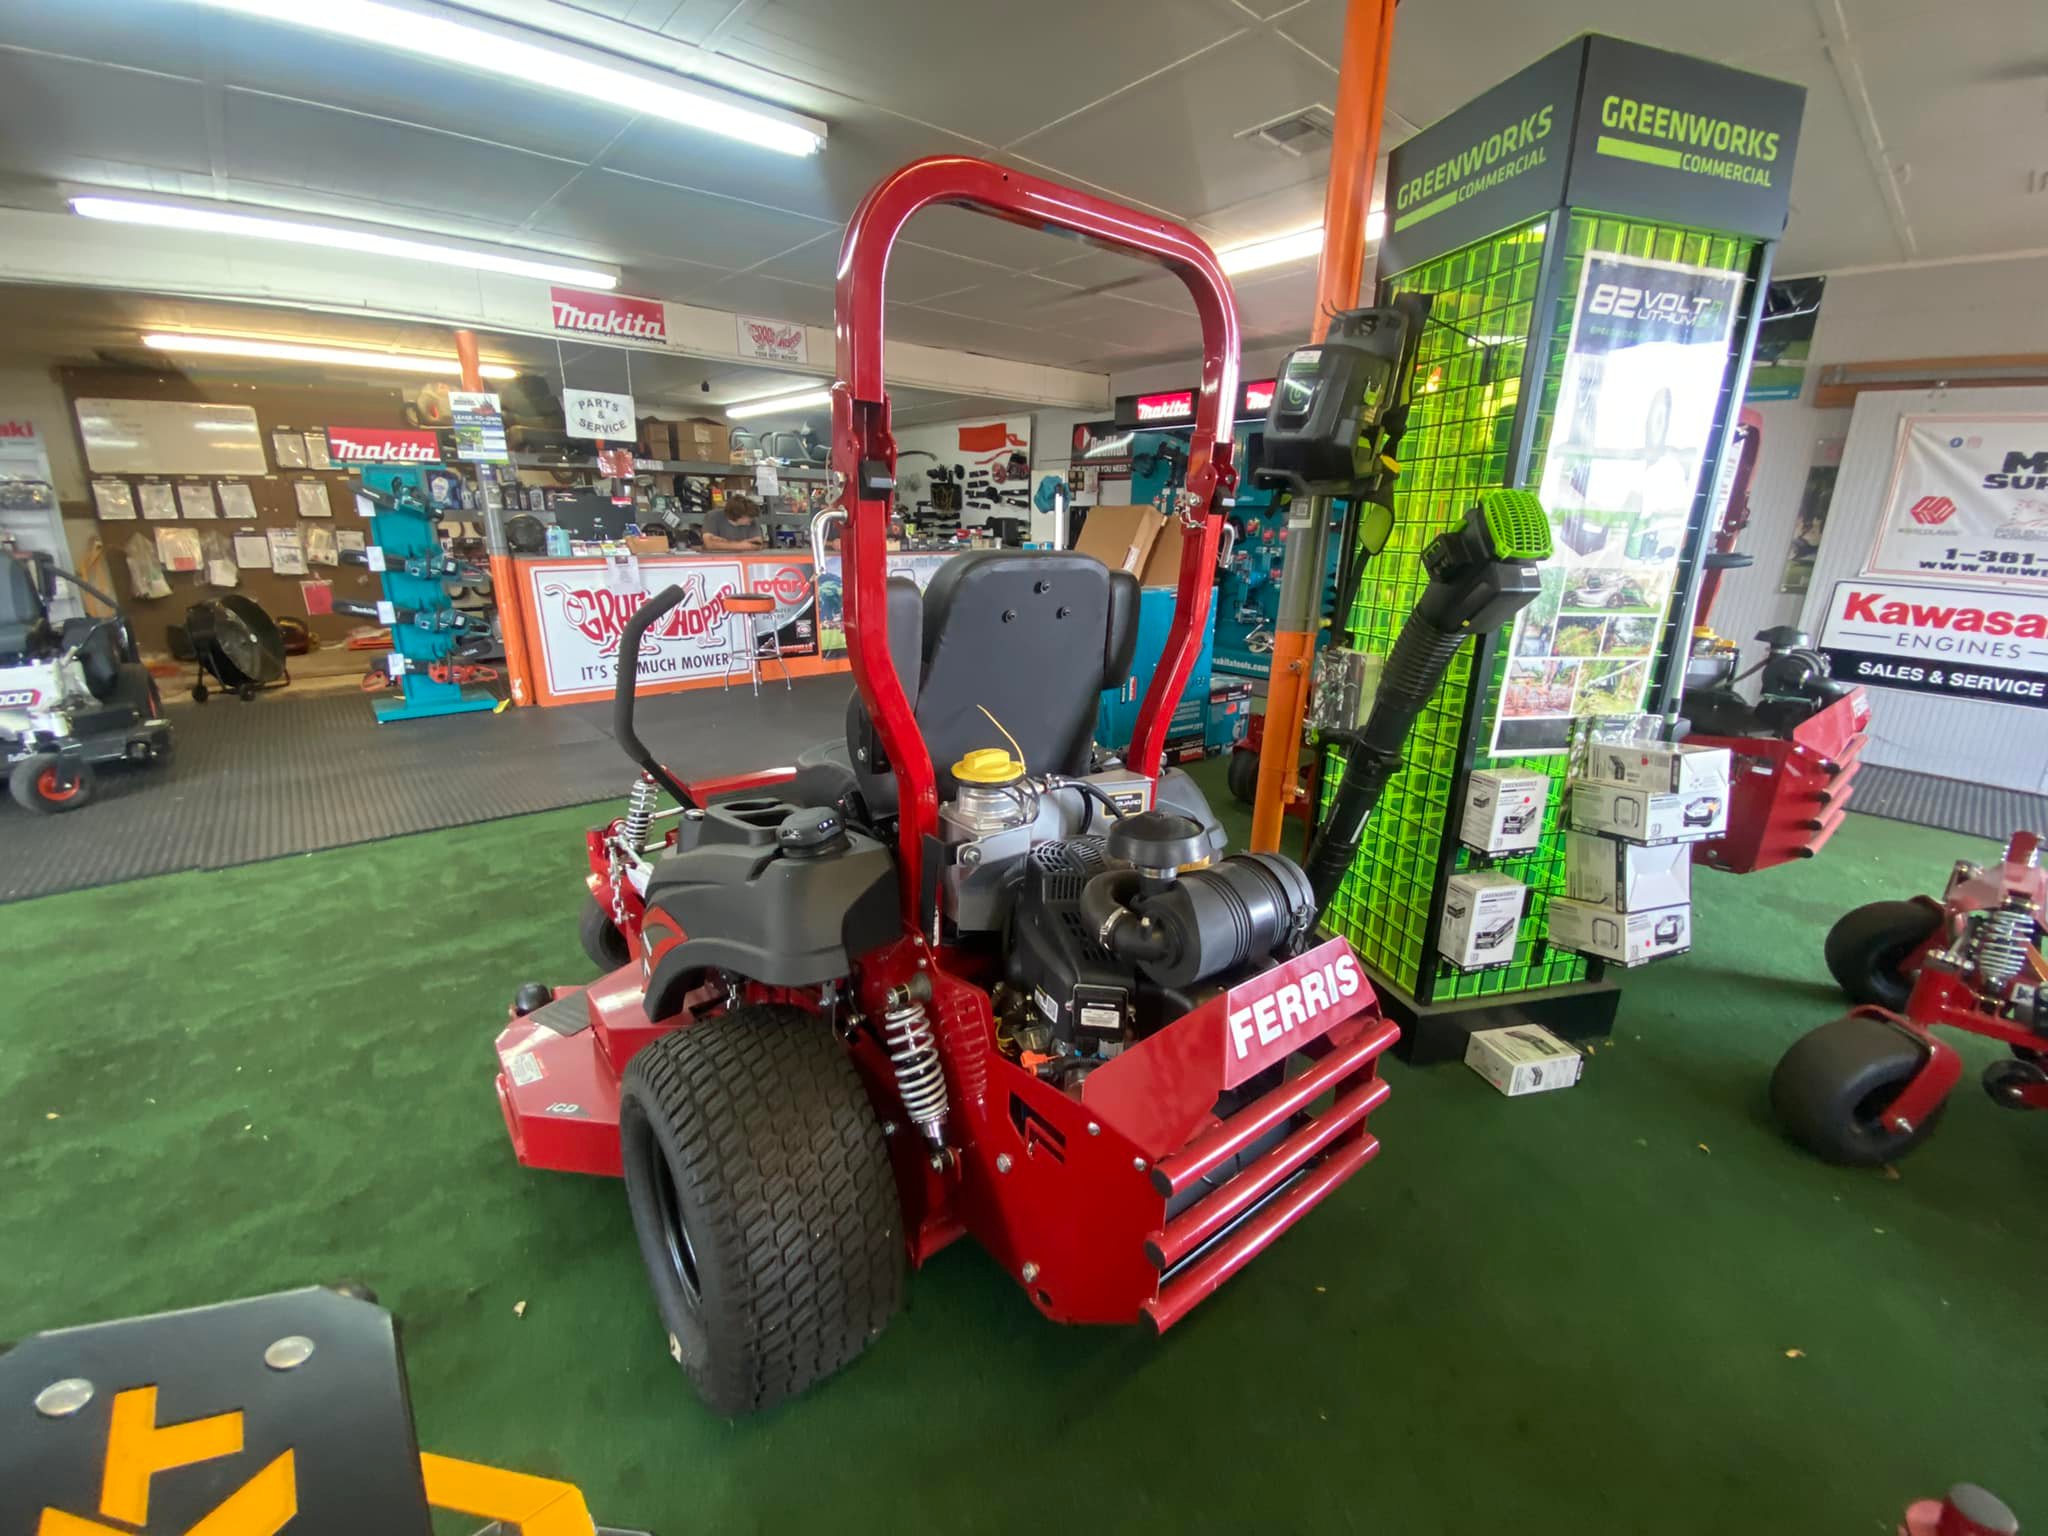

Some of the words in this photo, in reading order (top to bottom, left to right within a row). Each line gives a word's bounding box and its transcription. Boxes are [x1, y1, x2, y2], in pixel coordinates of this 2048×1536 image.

[1602, 95, 1780, 162] GREENWORKS
[1397, 105, 1553, 211] GREENWORKS
[1458, 147, 1547, 202] COMMERCIAL
[1682, 153, 1772, 188] COMMERCIAL
[1589, 283, 1642, 319] 82
[1644, 289, 1712, 315] VOLT
[578, 398, 619, 413] PARTS
[598, 410, 606, 419] &
[579, 418, 628, 434] SERVICE
[1897, 633, 2022, 659] ENGINES
[581, 664, 608, 680] IT'S
[637, 658, 676, 675] MUCH
[681, 653, 730, 671] MOWER
[1858, 662, 1924, 682] SALES
[1928, 671, 1944, 685] &
[1949, 673, 2046, 698] SERVICE
[1229, 954, 1359, 1060] FERRIS
